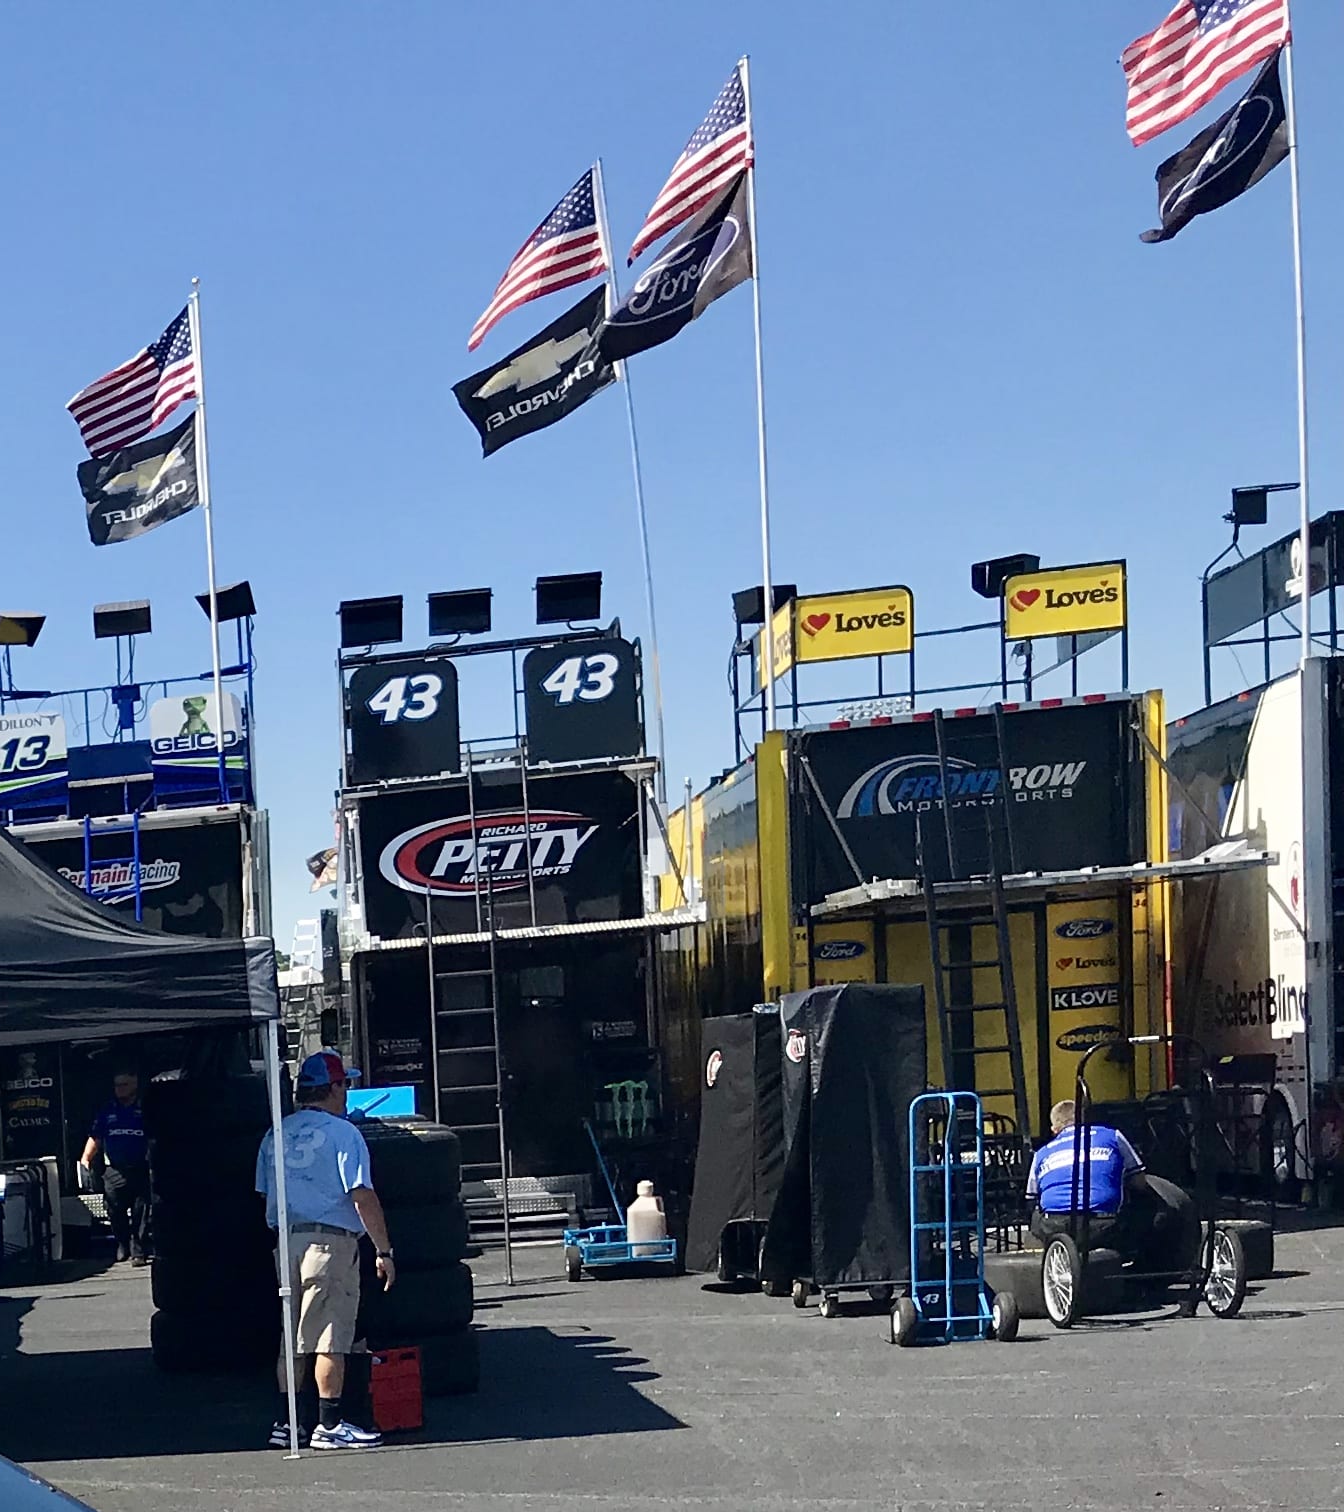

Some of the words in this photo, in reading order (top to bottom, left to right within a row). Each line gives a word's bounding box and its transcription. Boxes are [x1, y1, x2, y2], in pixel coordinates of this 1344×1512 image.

[1044, 580, 1119, 609] Love's
[835, 604, 906, 634] Love's
[541, 652, 620, 706] 43
[366, 673, 443, 725] 43
[0, 717, 42, 732] DILLON
[153, 730, 239, 754] GEICO
[896, 767, 1001, 800] FRONT
[1006, 761, 1086, 790] ROW
[897, 786, 1073, 814] MOTORSORTS
[480, 823, 547, 838] RICHARD
[430, 824, 600, 878] PETTY
[1064, 920, 1104, 938] Ford
[820, 943, 856, 960] Ford
[922, 1292, 940, 1304] 43
